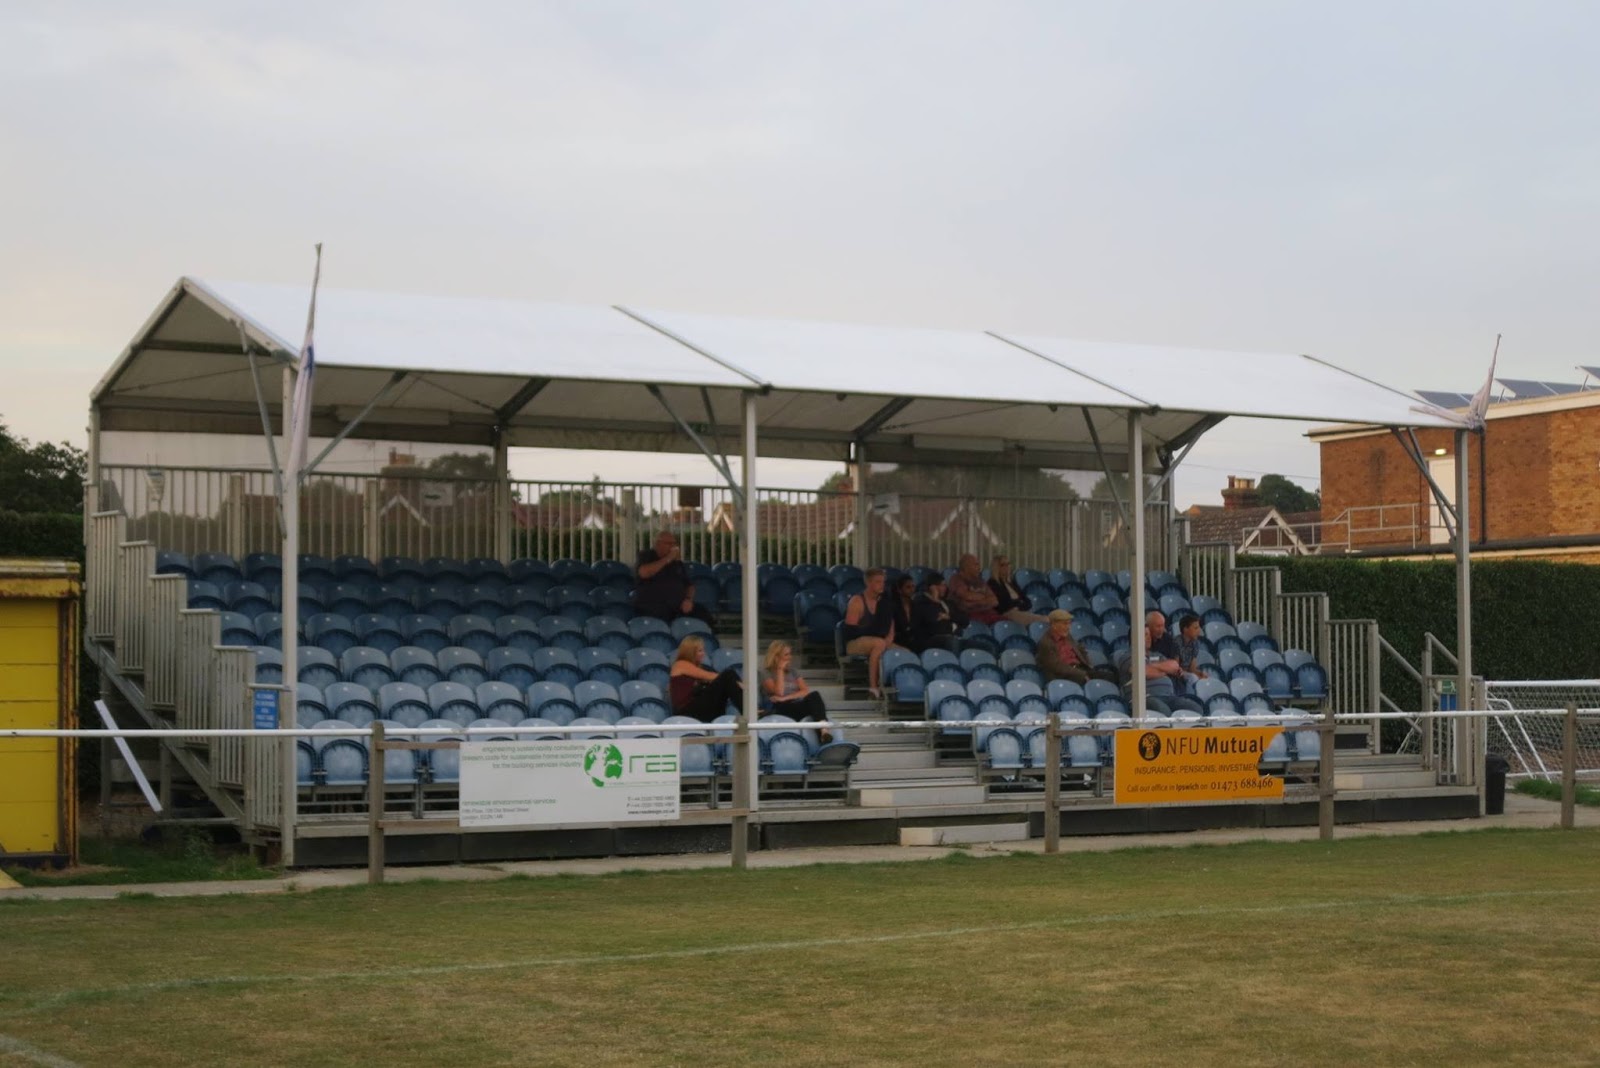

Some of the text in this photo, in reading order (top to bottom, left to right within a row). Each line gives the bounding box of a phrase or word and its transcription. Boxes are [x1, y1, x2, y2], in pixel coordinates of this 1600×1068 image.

[1166, 735, 1263, 755] NFU Mutual
[1134, 765, 1178, 775] INSURANCE,
[1180, 764, 1217, 774] PENSIONS,
[1127, 784, 1139, 792] Call
[1151, 783, 1168, 792] office
[1175, 782, 1199, 793] Ipswich
[1210, 781, 1238, 792] 01473
[1240, 777, 1274, 790] 688466
